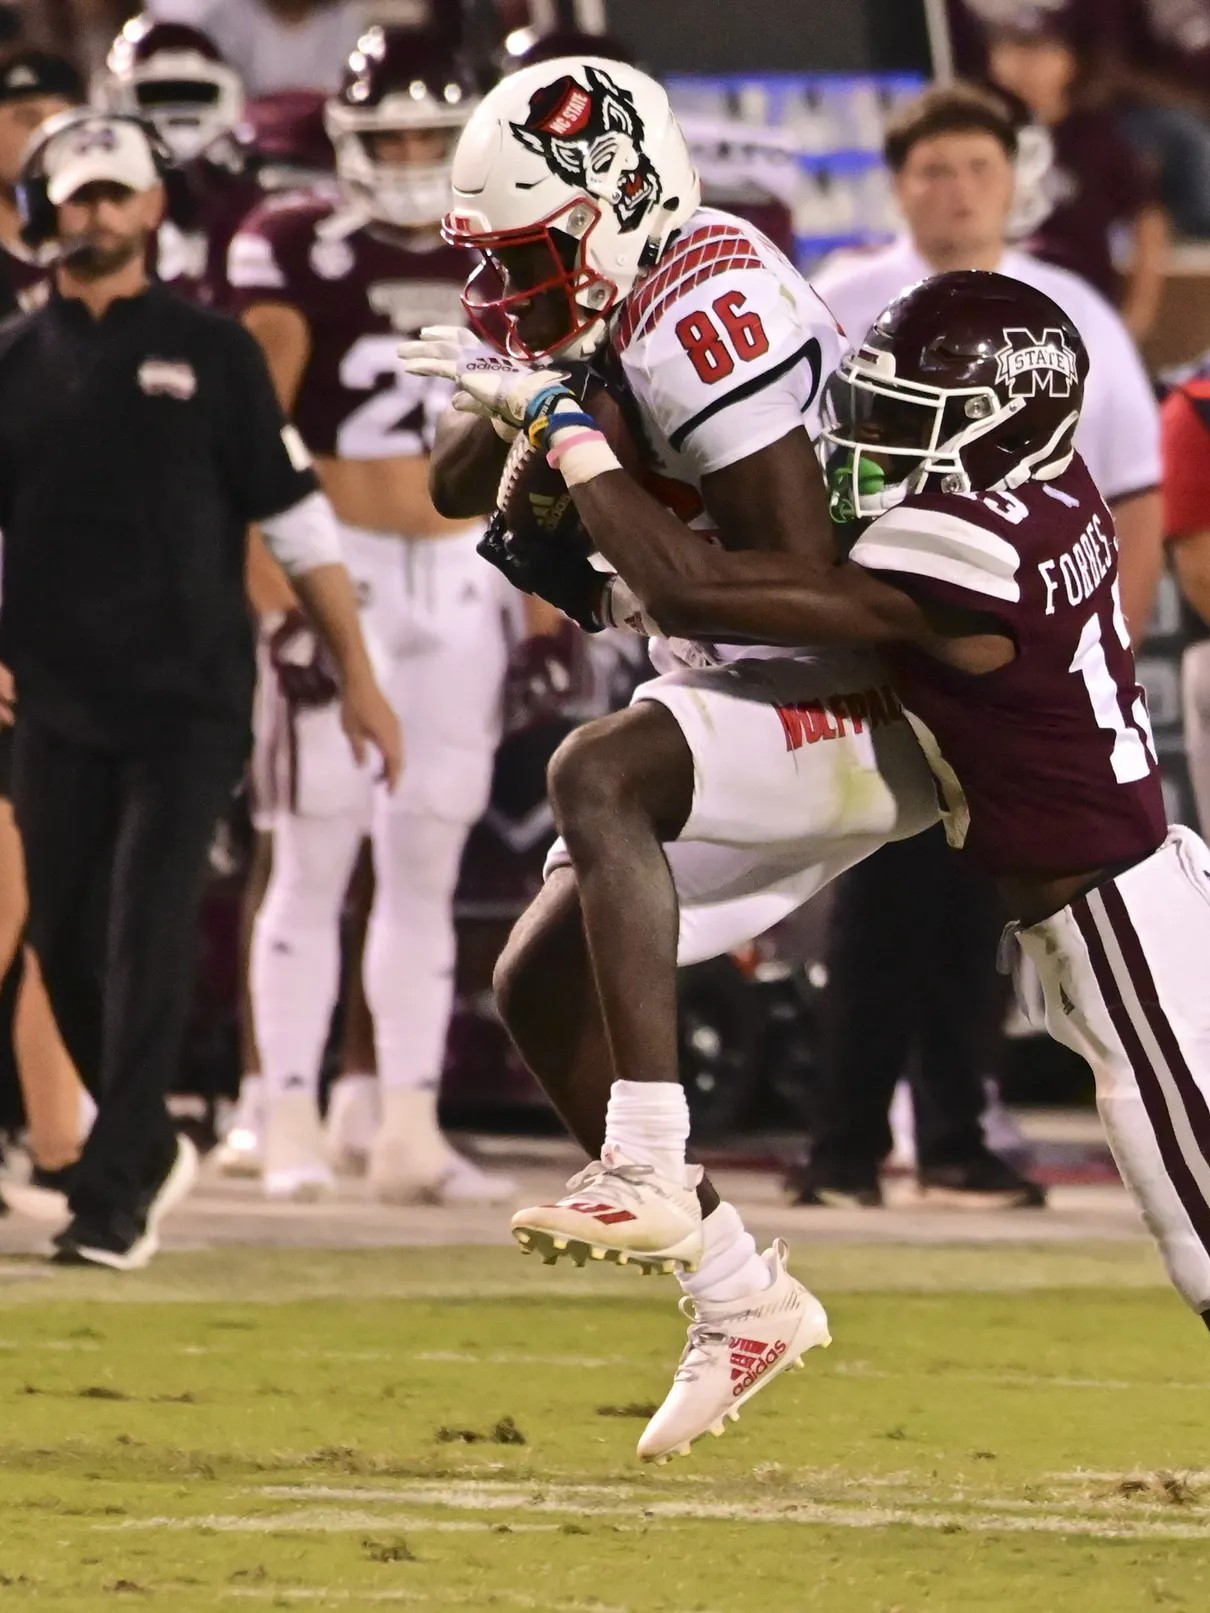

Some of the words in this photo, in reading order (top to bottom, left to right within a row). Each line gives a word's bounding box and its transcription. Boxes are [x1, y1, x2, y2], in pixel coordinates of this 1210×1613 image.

[550, 116, 572, 134] NC
[562, 92, 588, 122] STATE
[675, 290, 770, 386] 86
[1014, 349, 1066, 371] STATE
[1037, 513, 1113, 616] FORBES
[732, 1339, 787, 1397] adidas
